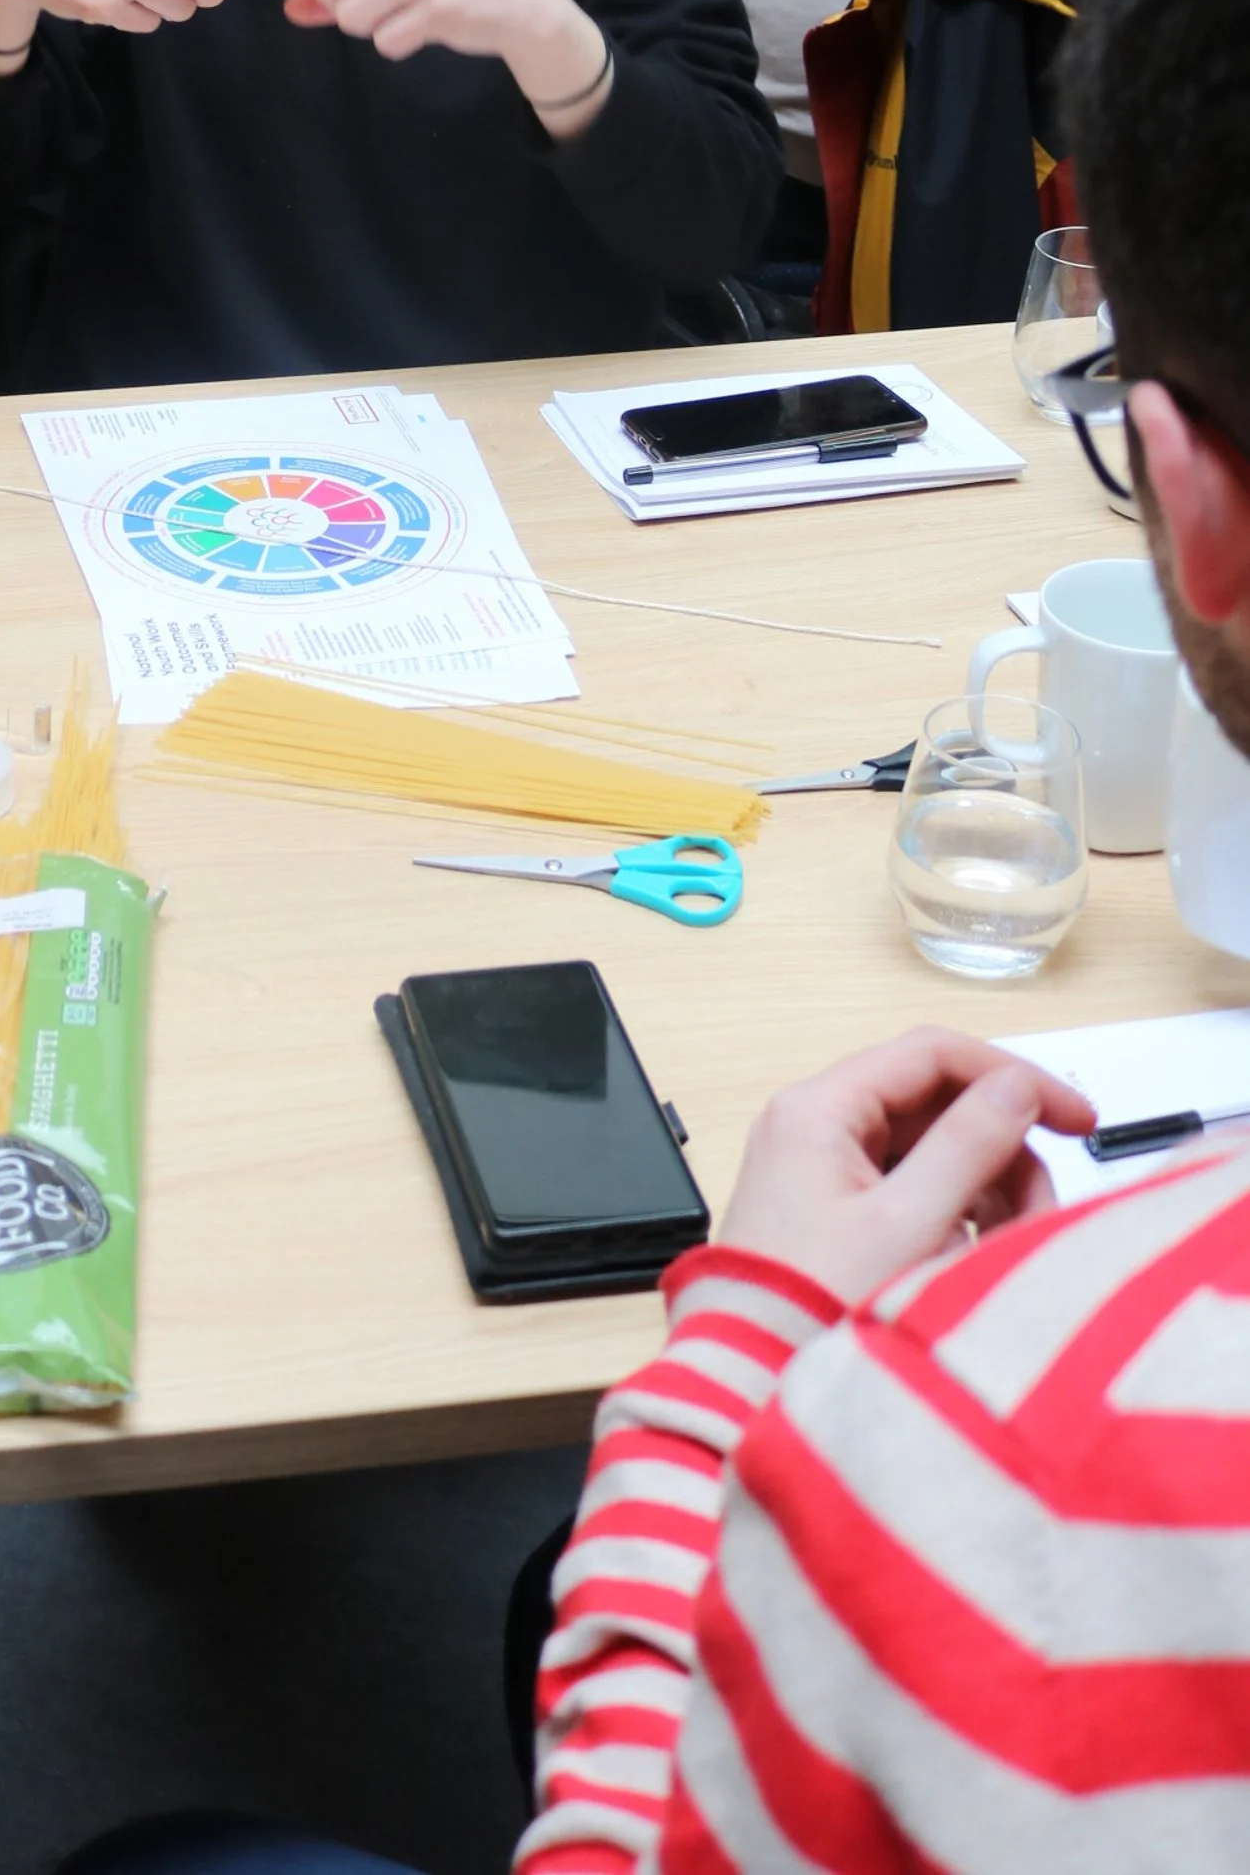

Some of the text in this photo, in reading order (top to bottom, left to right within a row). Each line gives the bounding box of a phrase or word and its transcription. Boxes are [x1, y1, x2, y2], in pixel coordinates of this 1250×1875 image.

[124, 633, 152, 678] National
[141, 617, 174, 676] Youth Work
[167, 621, 197, 674] Outcomes
[188, 623, 219, 672] and Skills
[205, 612, 236, 670] Framework
[28, 1029, 59, 1130] SPAGHETTI
